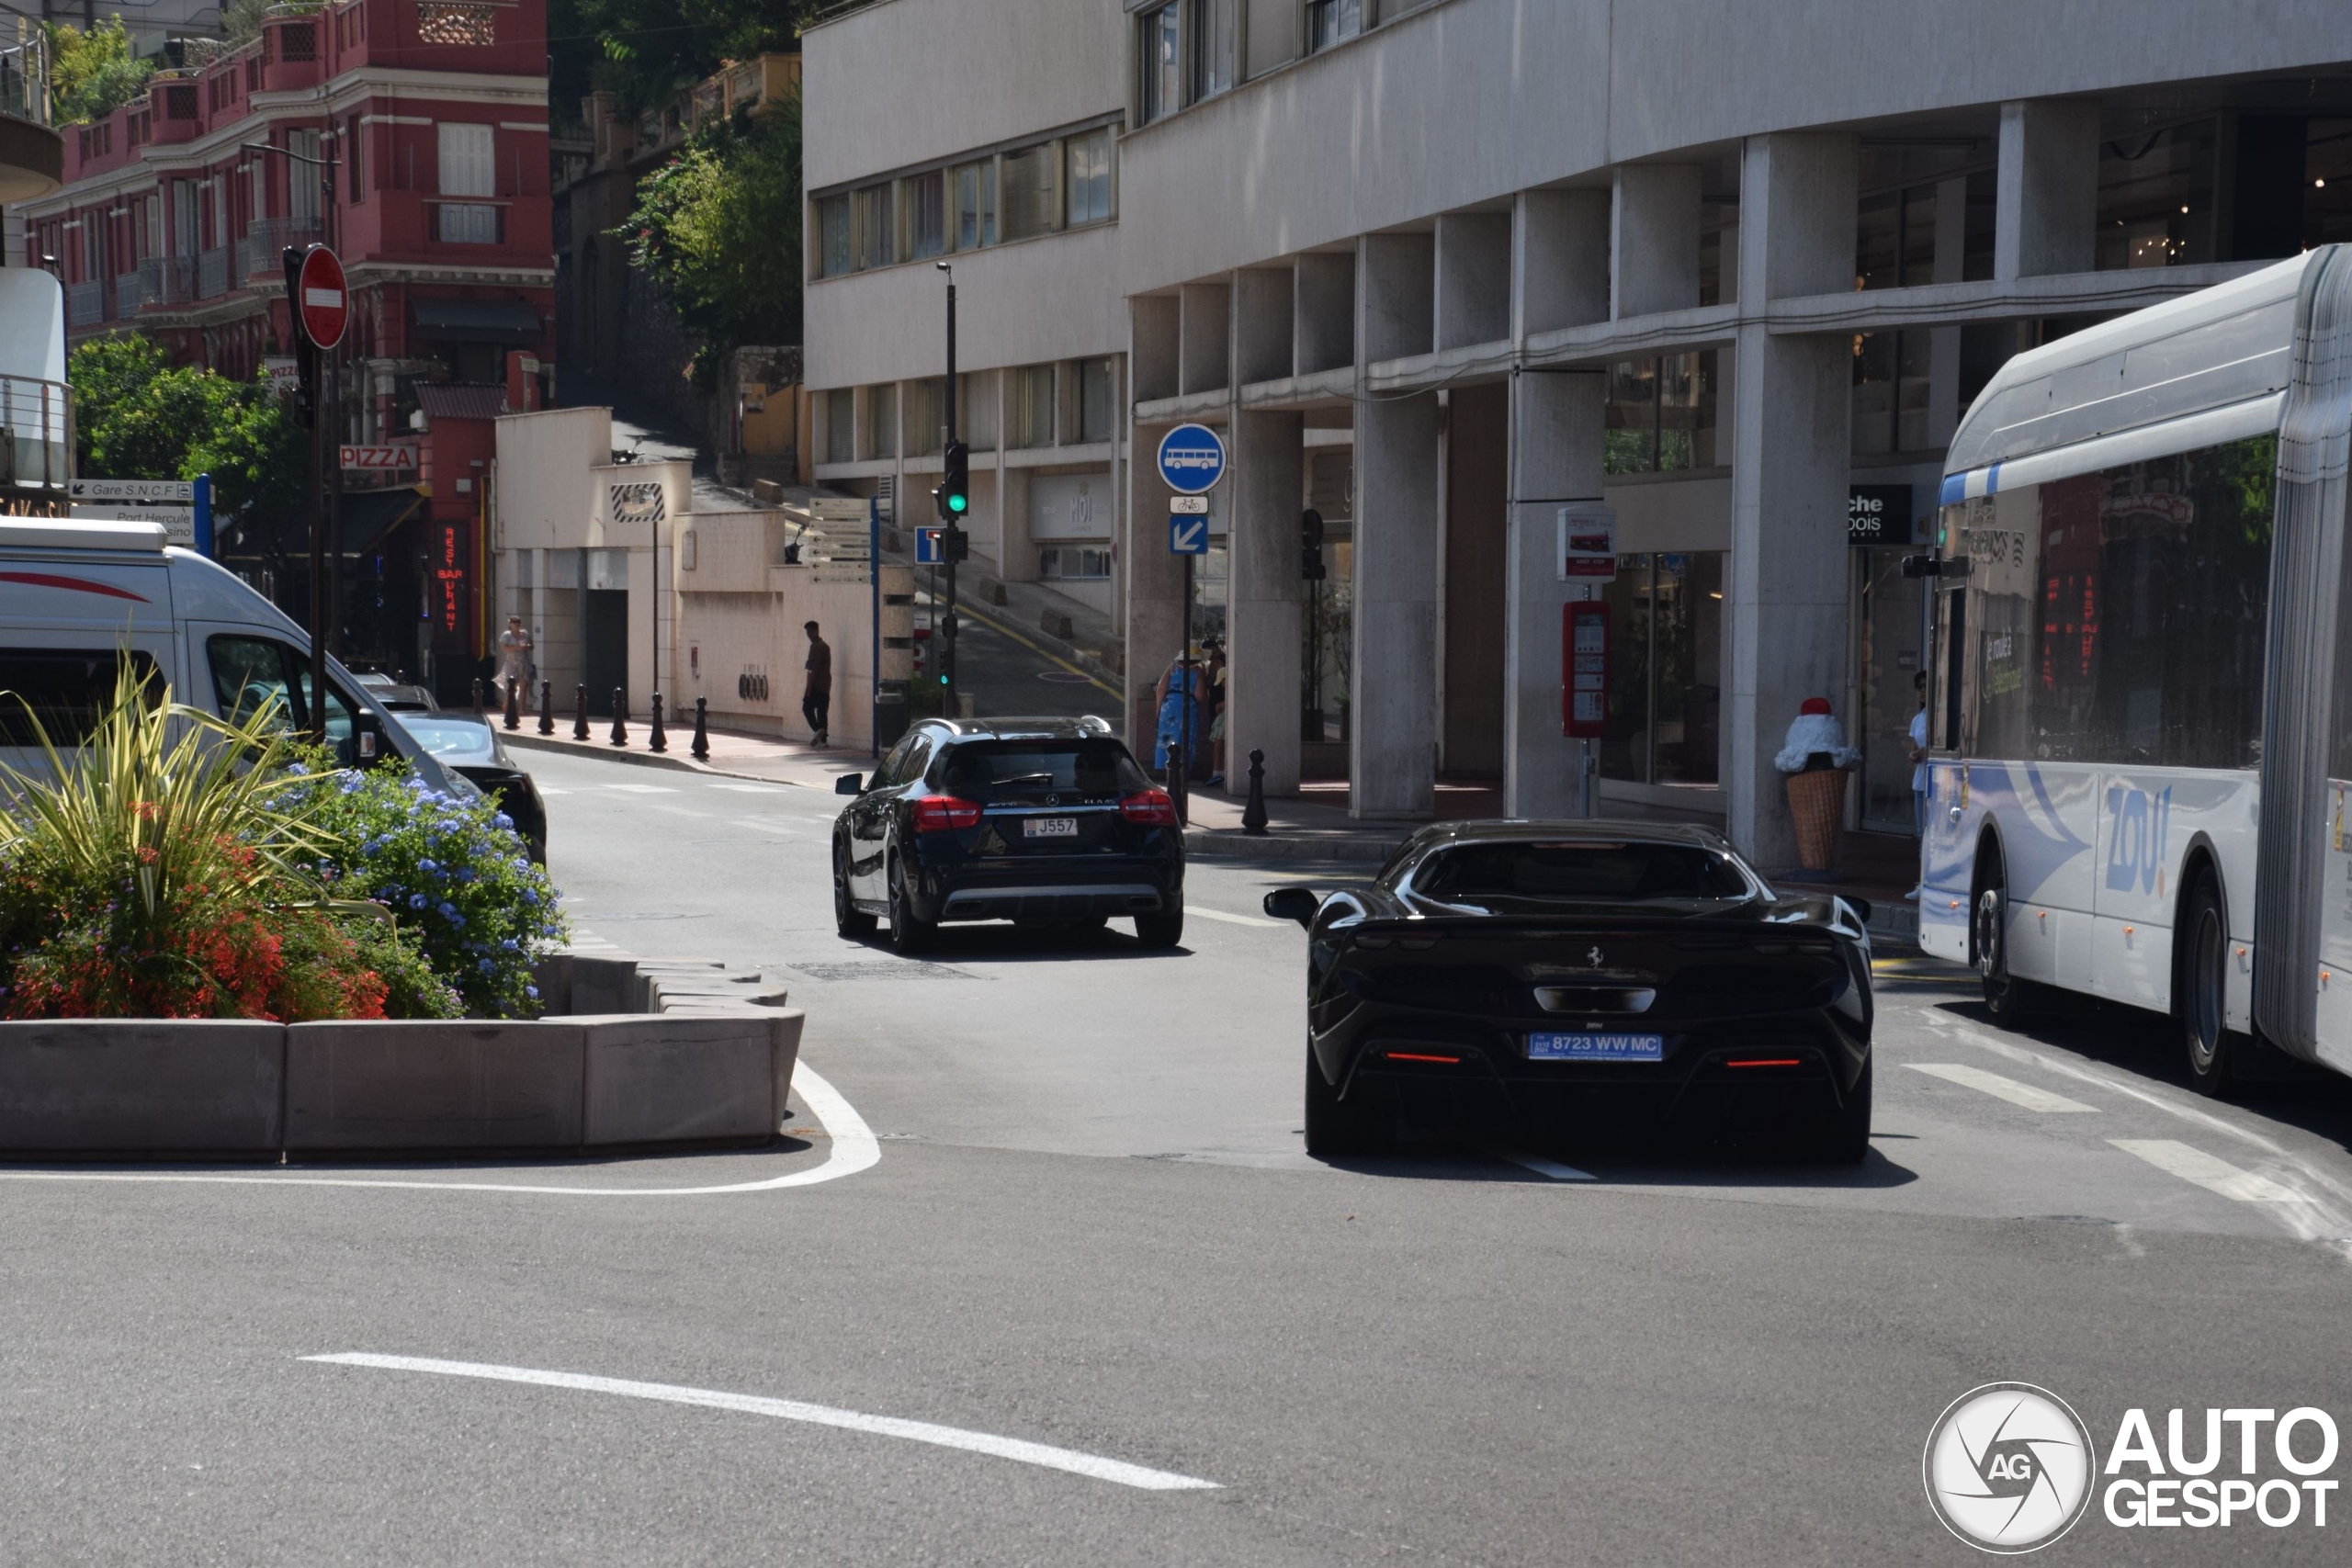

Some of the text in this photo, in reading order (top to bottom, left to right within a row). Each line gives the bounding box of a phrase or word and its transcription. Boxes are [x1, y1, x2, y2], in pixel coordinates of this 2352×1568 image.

[341, 447, 412, 468] PIZZA
[92, 484, 122, 496] Gare
[145, 512, 190, 525] Hercule
[437, 570, 463, 579] BAR
[1039, 819, 1074, 833] J557
[1552, 1036, 1657, 1052] 8723 WW MC
